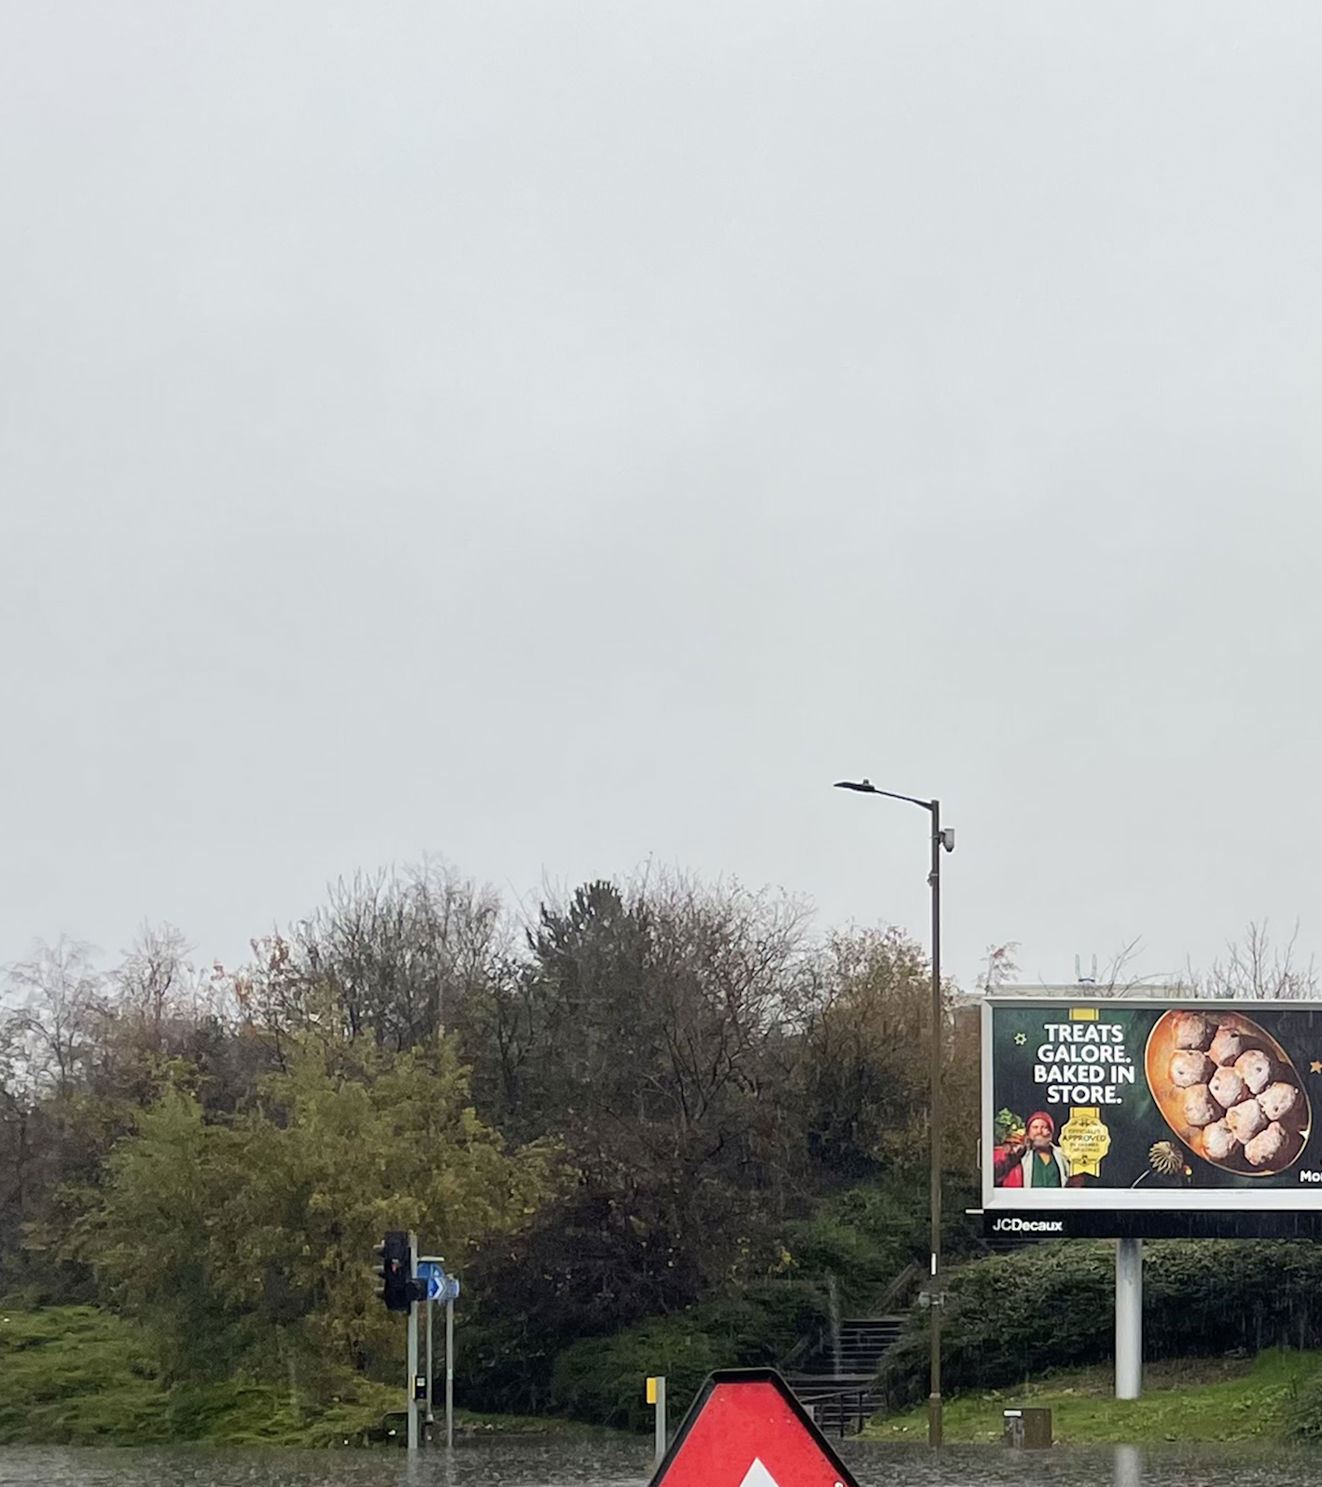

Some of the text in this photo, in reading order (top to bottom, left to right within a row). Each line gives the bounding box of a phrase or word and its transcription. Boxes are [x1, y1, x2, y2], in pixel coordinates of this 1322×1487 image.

[1044, 1025, 1123, 1042] TREATS
[1038, 1043, 1131, 1063] GALORE.
[1034, 1065, 1135, 1084] BAKED IN
[1047, 1085, 1122, 1104] STORE.
[992, 1218, 1063, 1232] JCDecaux
